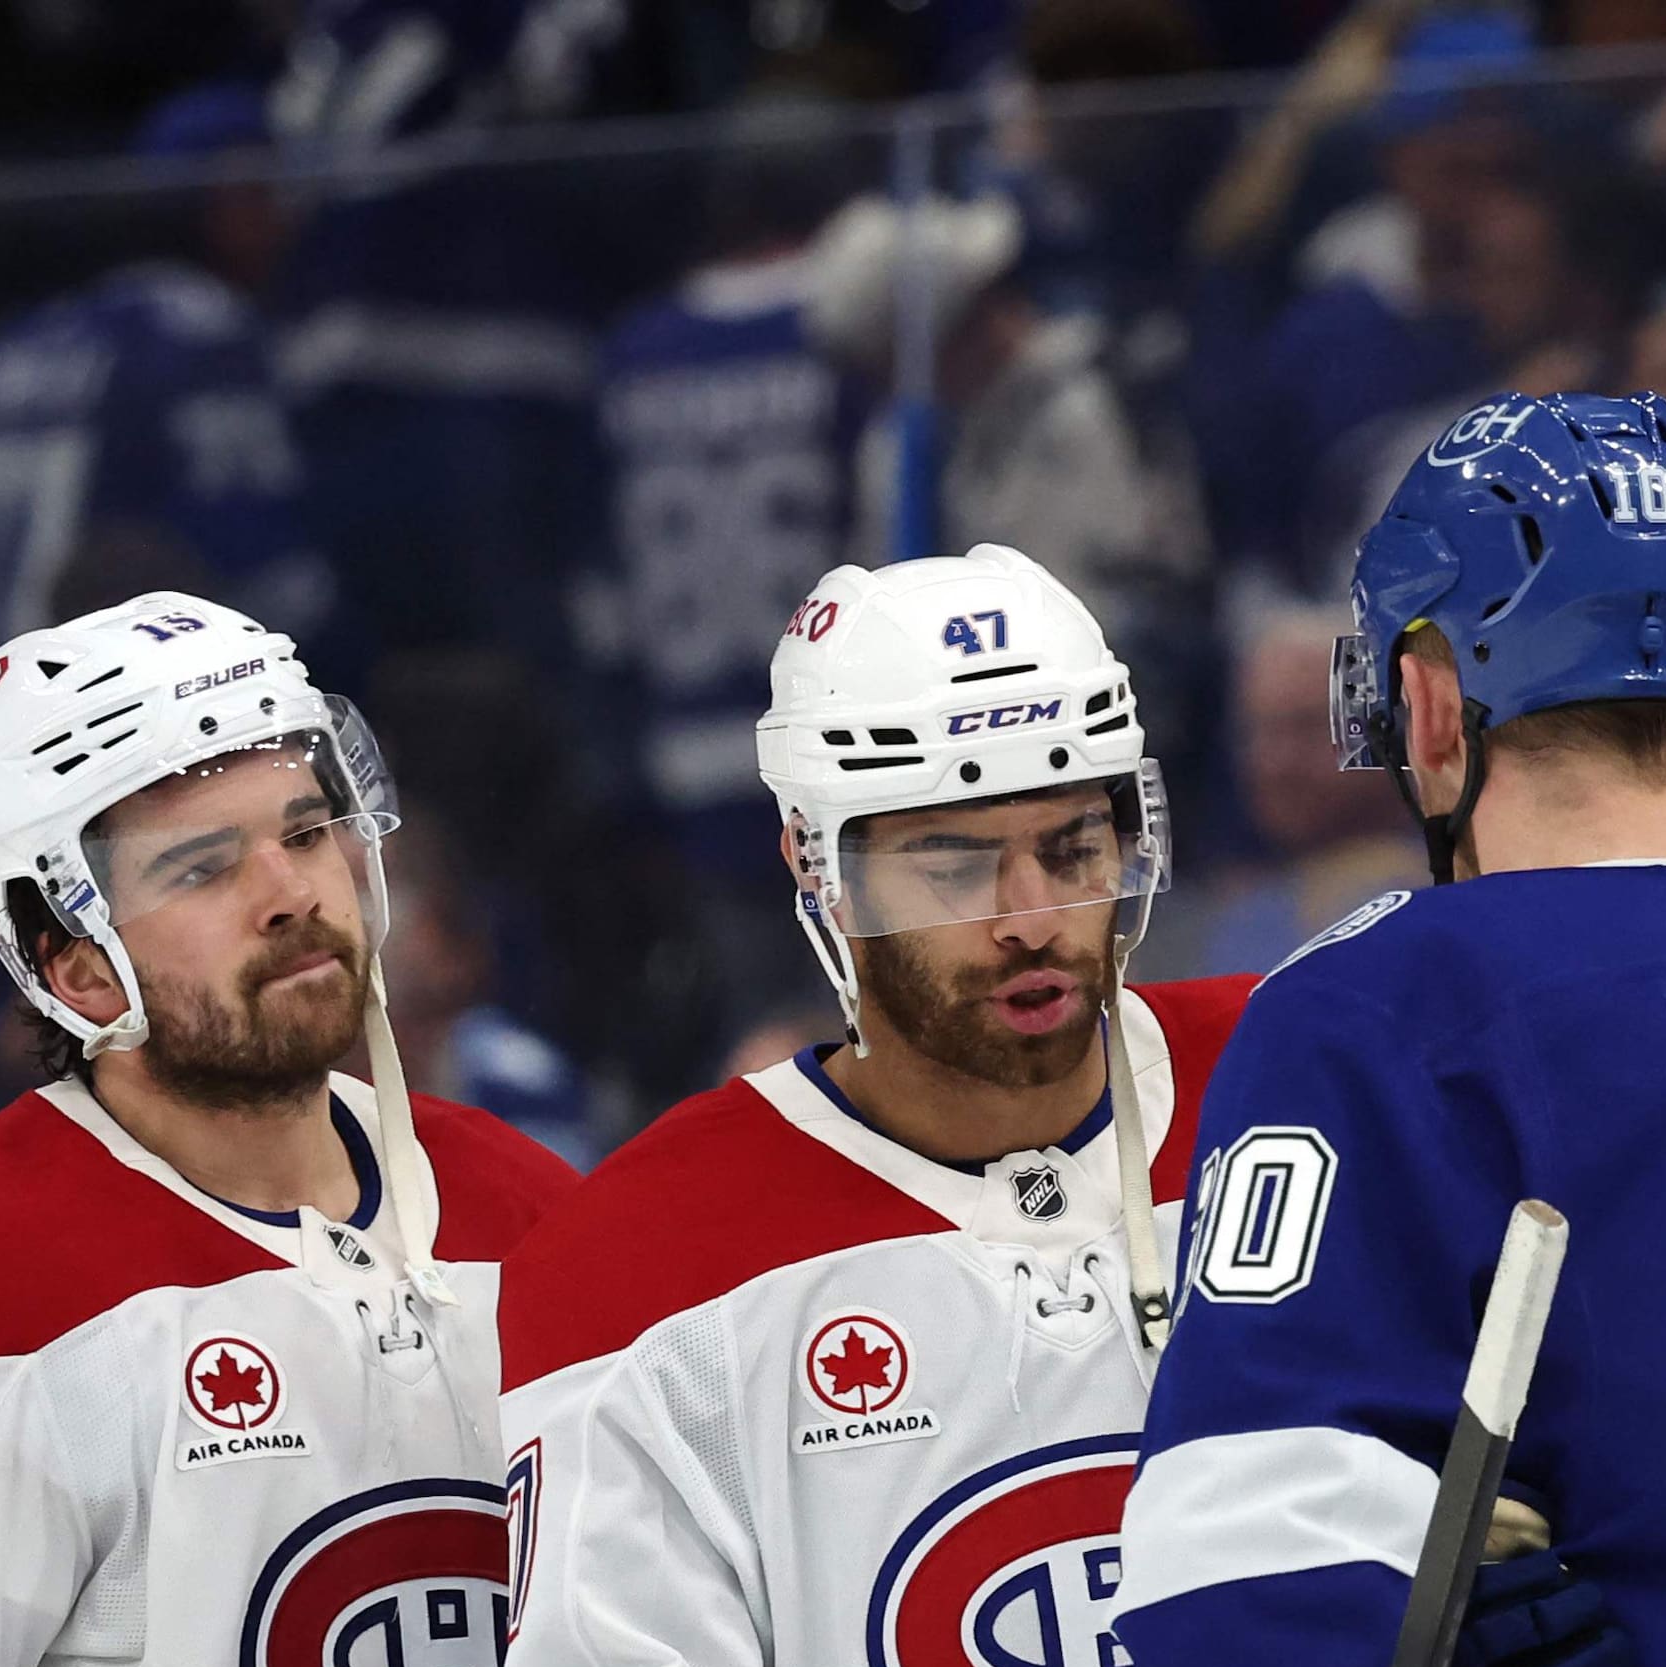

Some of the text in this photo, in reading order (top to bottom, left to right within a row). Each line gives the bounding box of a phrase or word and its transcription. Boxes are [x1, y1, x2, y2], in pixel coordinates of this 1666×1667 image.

[941, 608, 1009, 657] 47
[946, 699, 1063, 736] CCM
[802, 1415, 934, 1447] AIR CANADA
[186, 1435, 307, 1463] AIR CANADA
